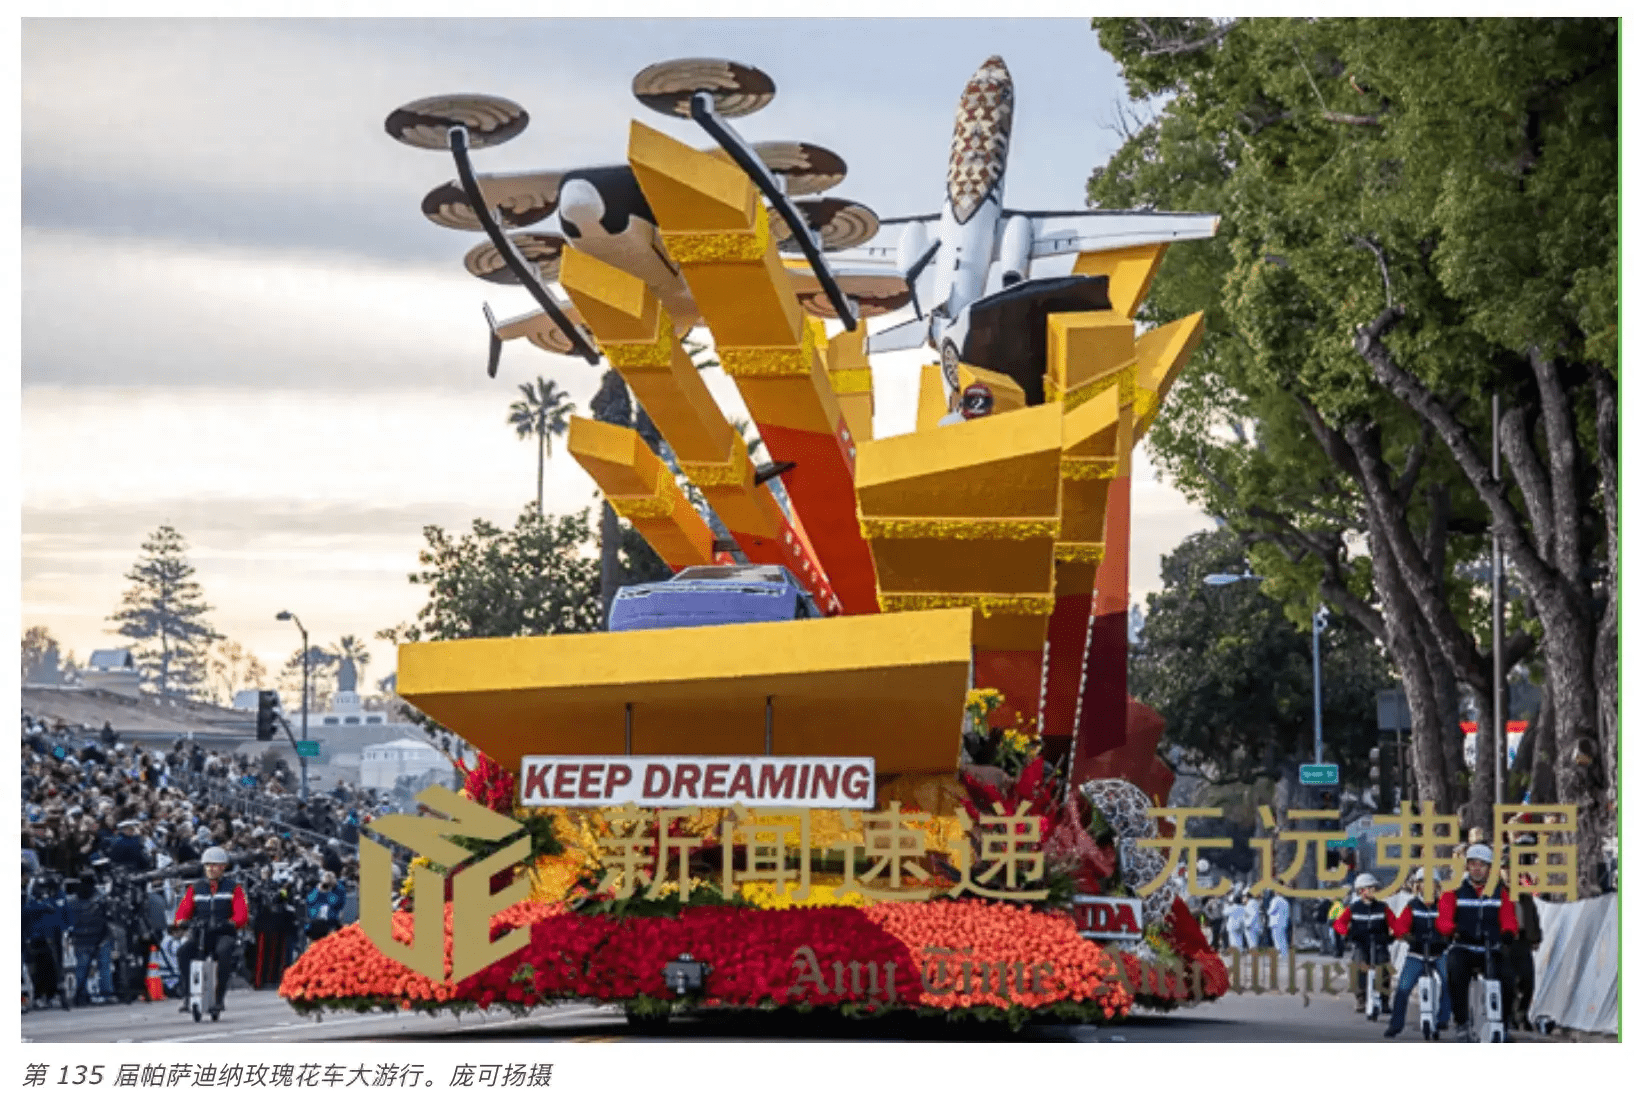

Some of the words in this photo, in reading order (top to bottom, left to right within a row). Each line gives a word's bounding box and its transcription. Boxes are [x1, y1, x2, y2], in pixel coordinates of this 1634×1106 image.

[524, 763, 633, 799] KEEP
[642, 763, 871, 800] DREAMING
[1074, 902, 1142, 933] NDA
